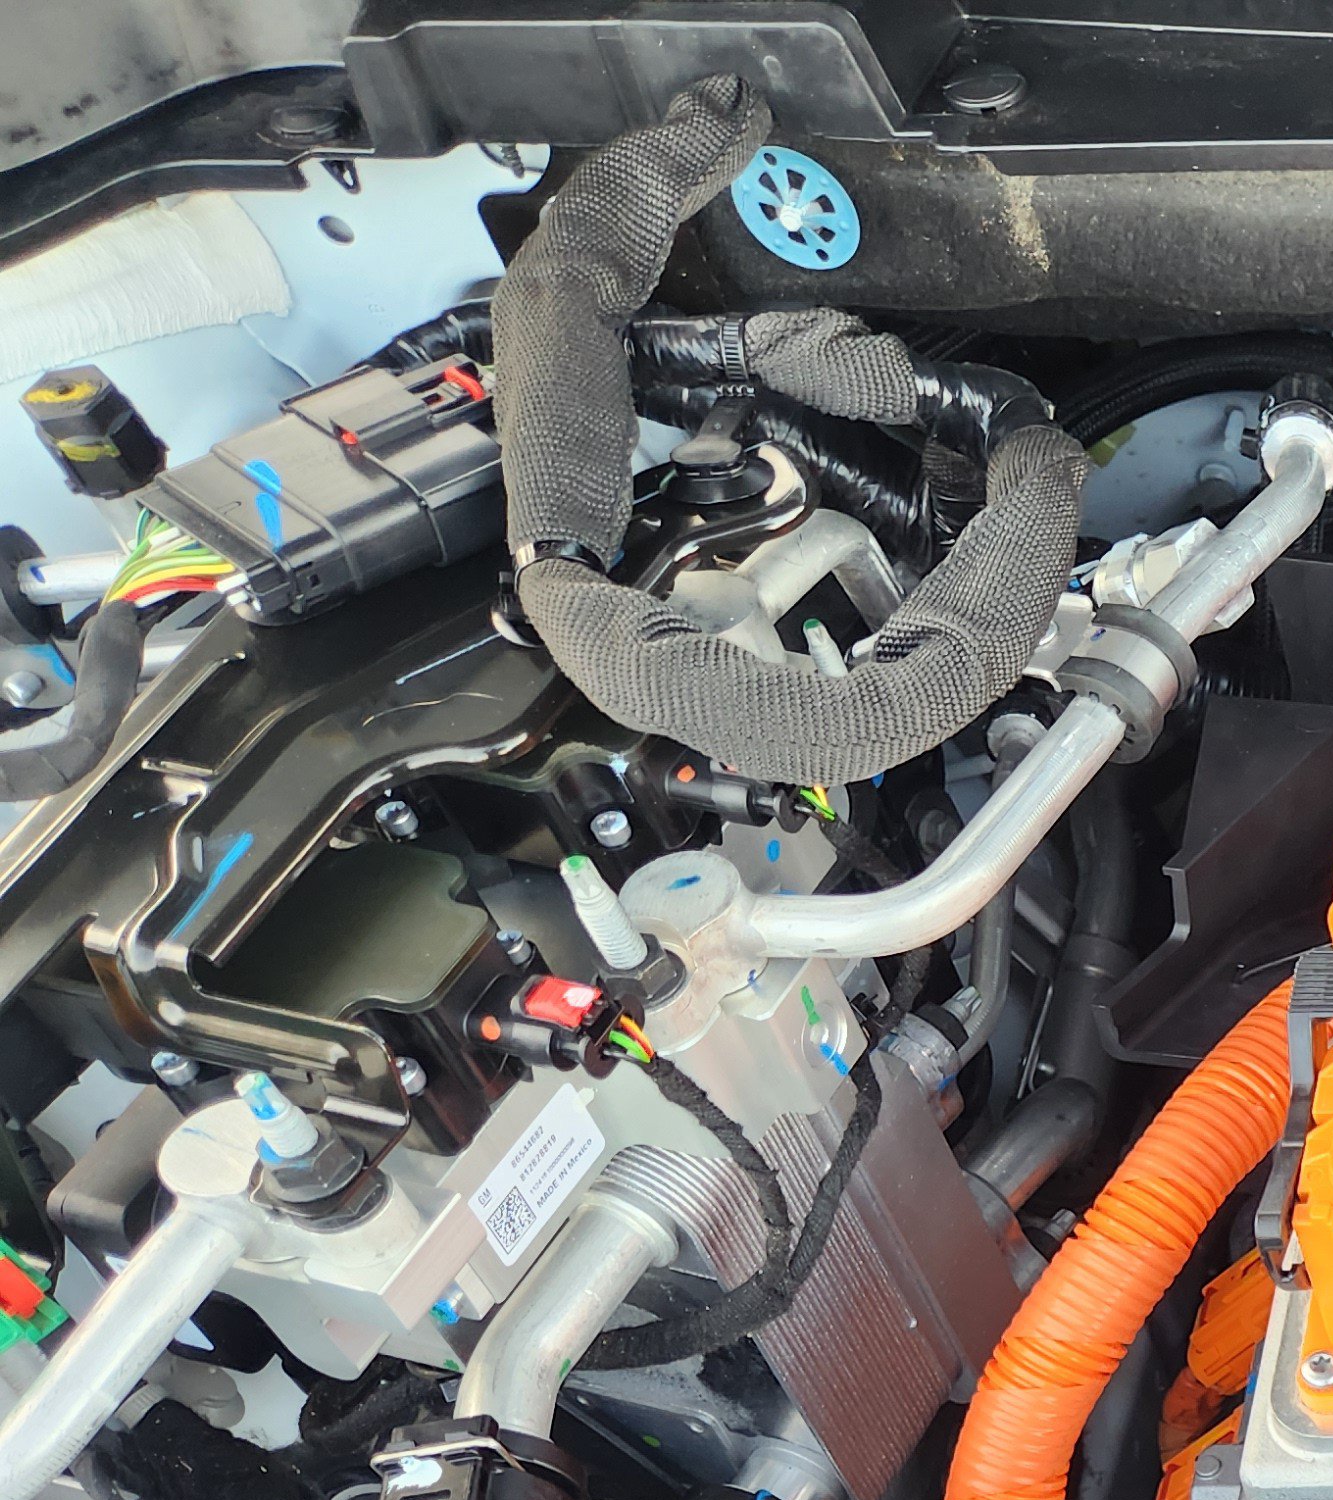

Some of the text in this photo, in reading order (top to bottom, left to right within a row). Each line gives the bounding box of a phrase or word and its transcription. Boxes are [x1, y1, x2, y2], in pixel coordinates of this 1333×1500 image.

[536, 1179, 559, 1208] MADE
[558, 1168, 569, 1181] IN
[567, 1138, 592, 1170] Mexico
[477, 1188, 492, 1206] GM
